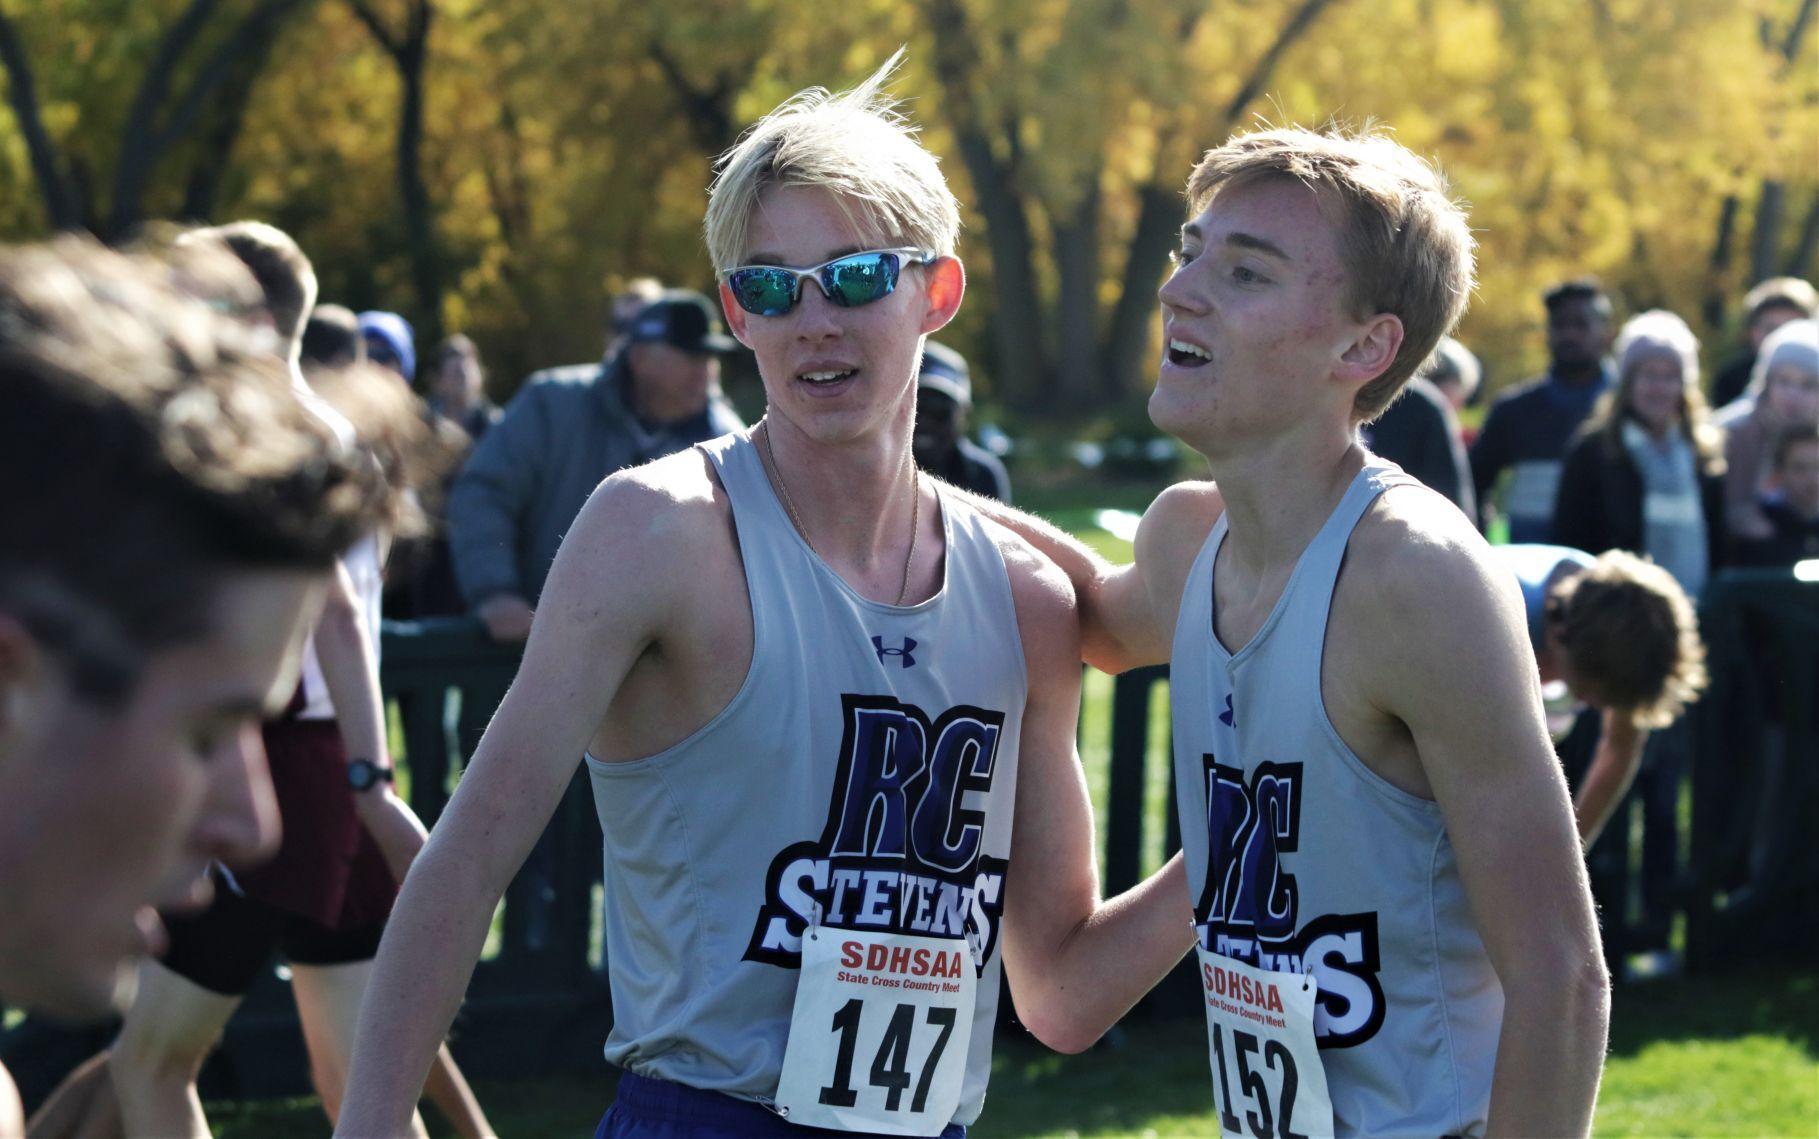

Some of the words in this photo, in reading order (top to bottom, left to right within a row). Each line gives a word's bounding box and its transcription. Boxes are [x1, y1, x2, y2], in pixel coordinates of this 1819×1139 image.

[829, 707, 999, 873] RC
[761, 857, 1001, 967] STEVENS
[837, 971, 868, 985] State
[872, 975, 900, 988] Cross
[902, 979, 940, 994] Country
[942, 982, 960, 993] Meet
[840, 941, 962, 979] SDHSAA
[1204, 962, 1284, 1014] SDHSAA
[1220, 1000, 1239, 1015] Cross
[1240, 1006, 1264, 1025] Country
[1266, 1015, 1286, 1028] Meet
[818, 998, 957, 1113] 147
[1213, 1022, 1308, 1139] 152
